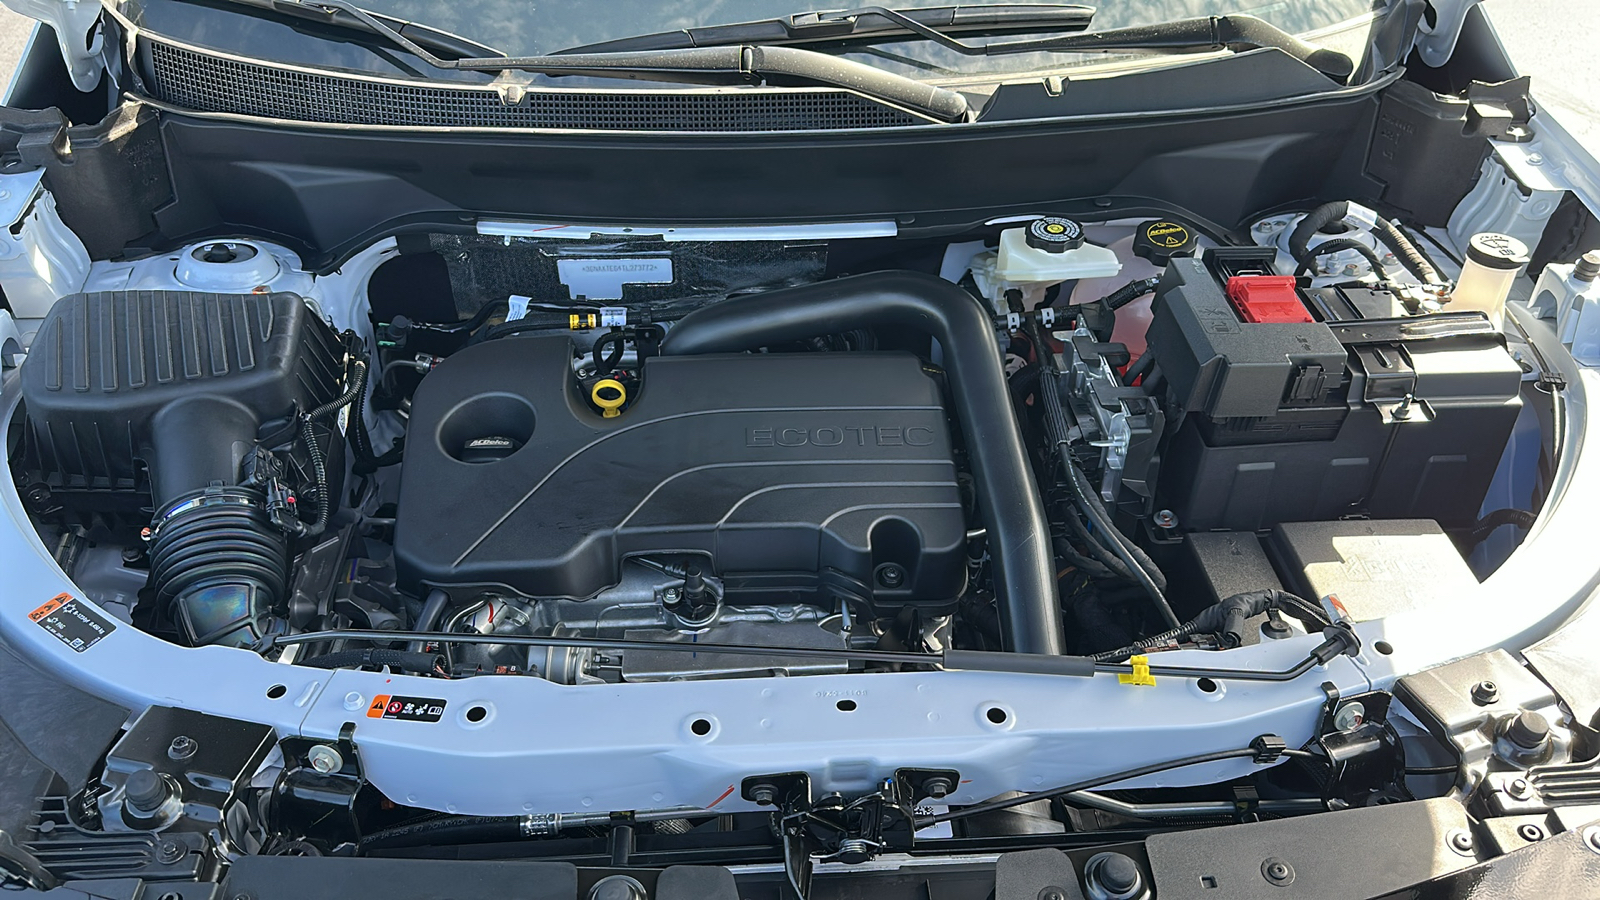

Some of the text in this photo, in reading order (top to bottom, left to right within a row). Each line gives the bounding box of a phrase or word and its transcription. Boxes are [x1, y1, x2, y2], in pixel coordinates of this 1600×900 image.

[1149, 227, 1182, 236] ACDelco
[745, 426, 935, 448] ECOTEC
[469, 439, 510, 447] ACDelco
